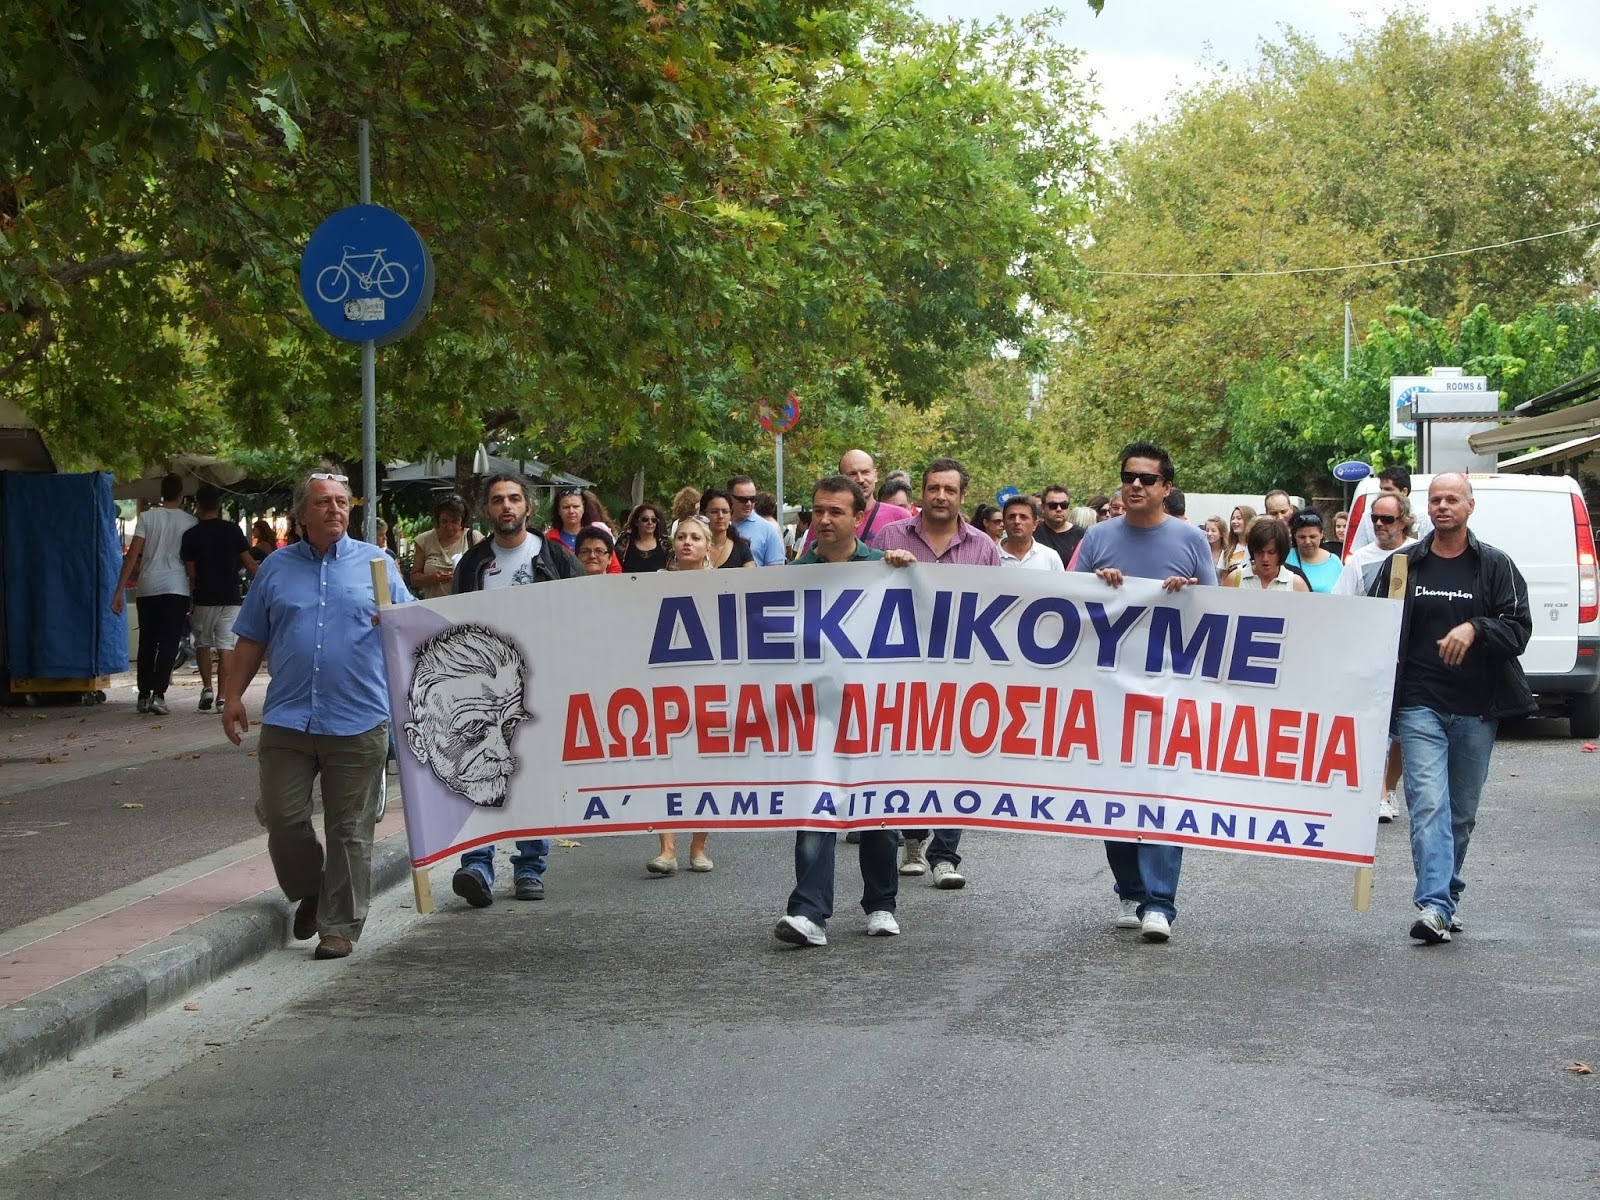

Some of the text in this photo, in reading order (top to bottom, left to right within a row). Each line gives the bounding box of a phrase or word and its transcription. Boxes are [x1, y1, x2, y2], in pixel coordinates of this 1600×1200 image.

[1446, 382, 1482, 391] ROOMS &
[648, 588, 1287, 685] ΔΙΕΚΔΙΚΟΥΜΕ
[562, 680, 1360, 788] ΔΩΡΕΑΝ ΔΗΜΟΣΙΑ ΠΑΙΔΕΙΑ
[667, 791, 785, 817] ΕΛΜΕ
[812, 789, 1326, 848] ΑΙΤΩΛΟΑΚΑΡΝΑΝΙΑΣ
